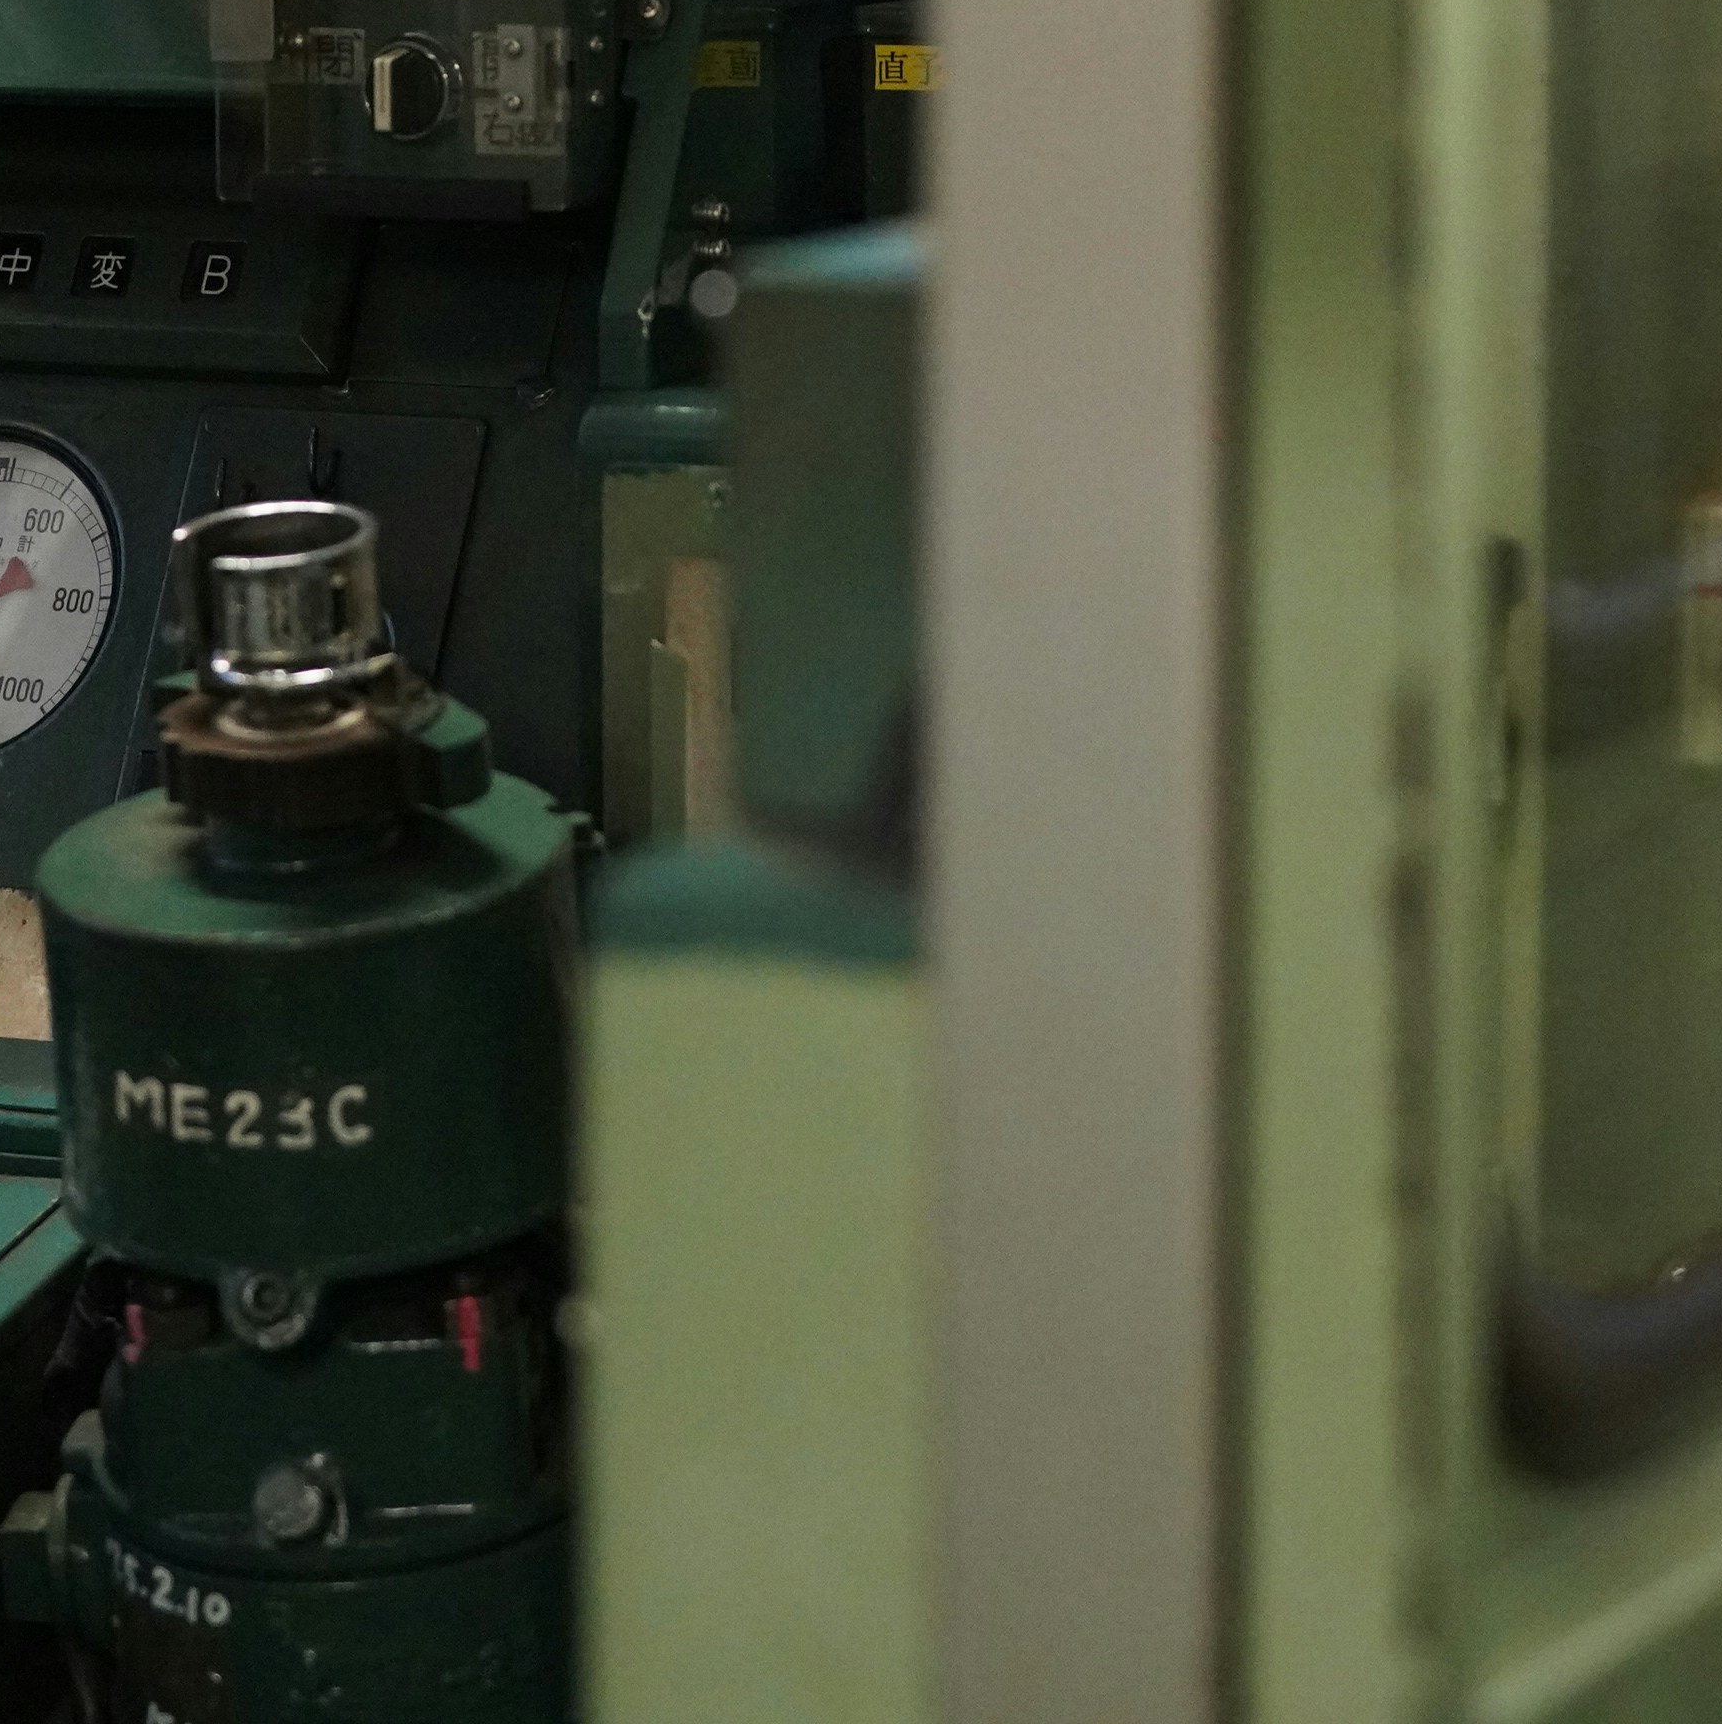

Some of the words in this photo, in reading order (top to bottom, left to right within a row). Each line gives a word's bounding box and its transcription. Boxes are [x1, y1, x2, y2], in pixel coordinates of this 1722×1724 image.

[89, 253, 127, 291] 変
[199, 254, 233, 295] B
[23, 507, 65, 534] 600
[52, 587, 95, 615] 800
